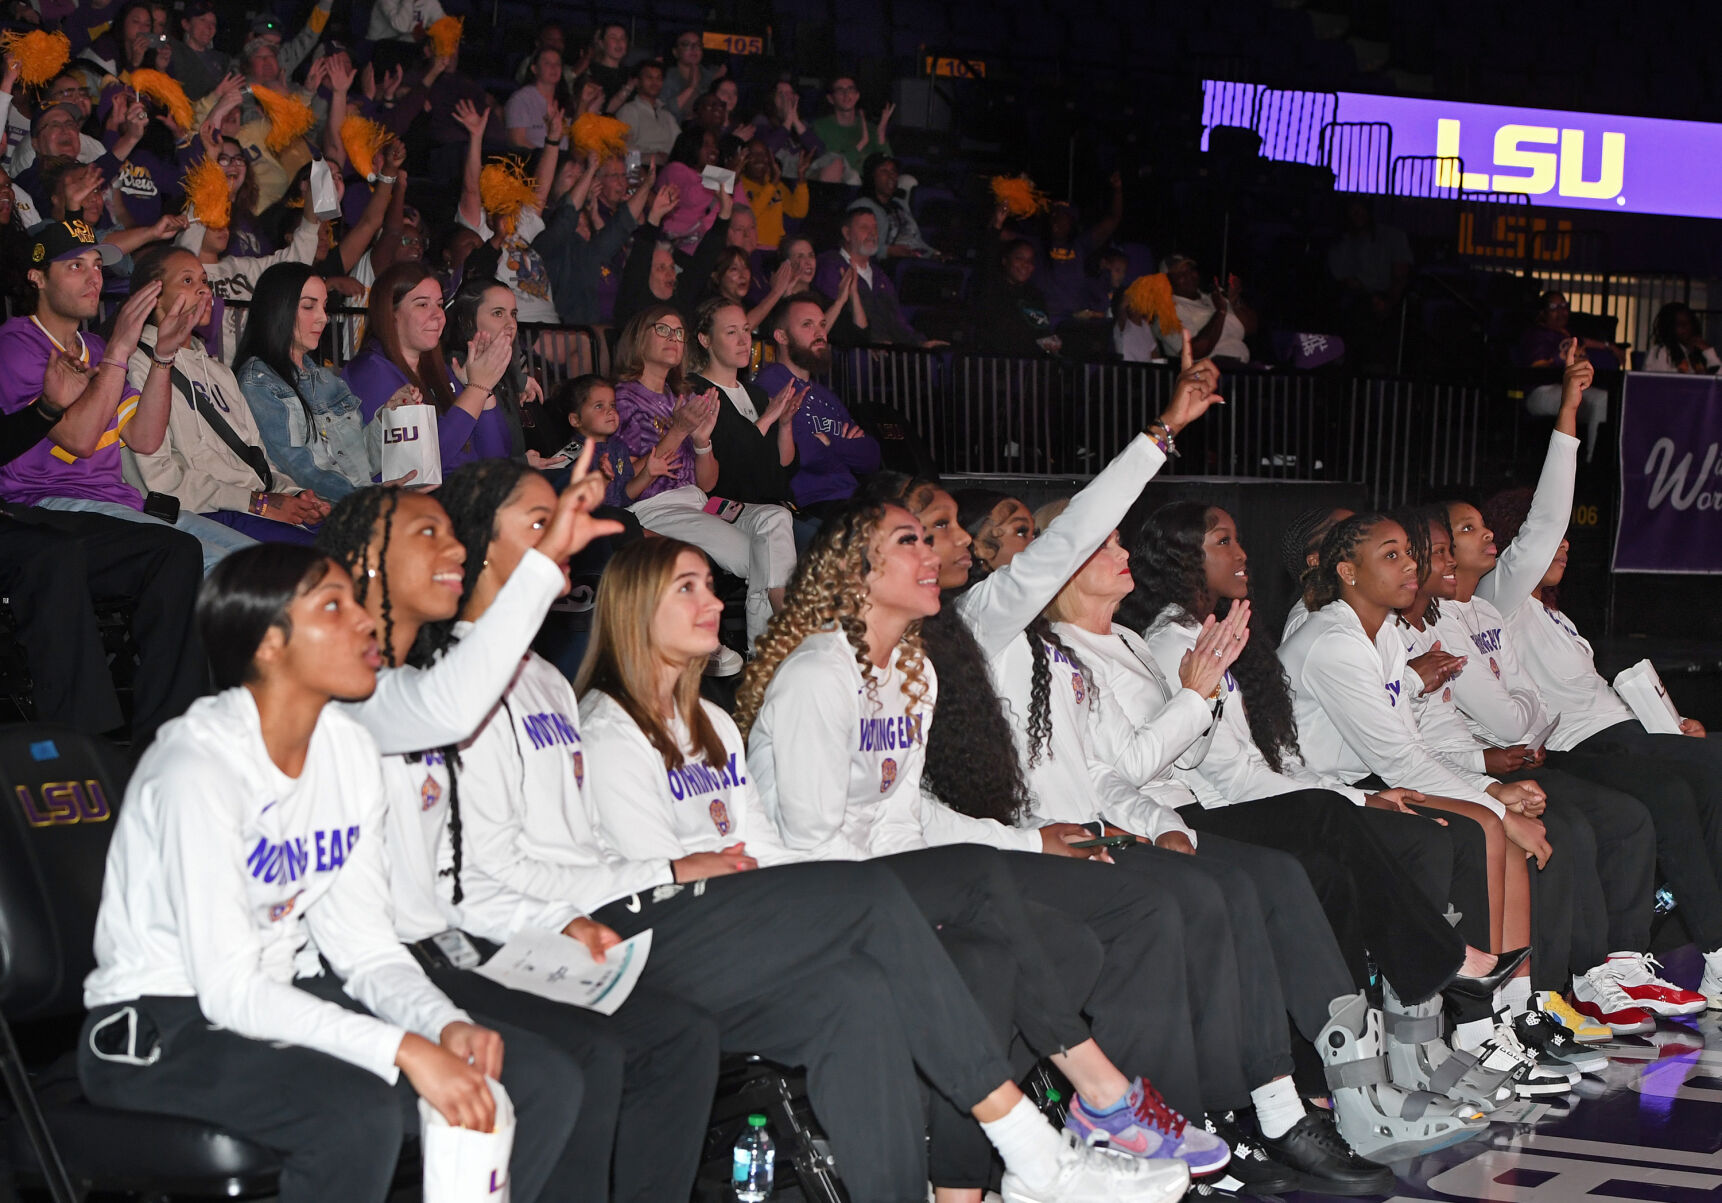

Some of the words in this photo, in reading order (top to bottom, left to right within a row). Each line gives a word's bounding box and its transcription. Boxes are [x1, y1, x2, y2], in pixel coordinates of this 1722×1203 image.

[724, 36, 761, 55] 105
[1434, 117, 1626, 200] LSU
[62, 218, 95, 242] LSU
[1458, 212, 1572, 262] LSU
[383, 425, 419, 445] LSU
[15, 779, 111, 828] LSU
